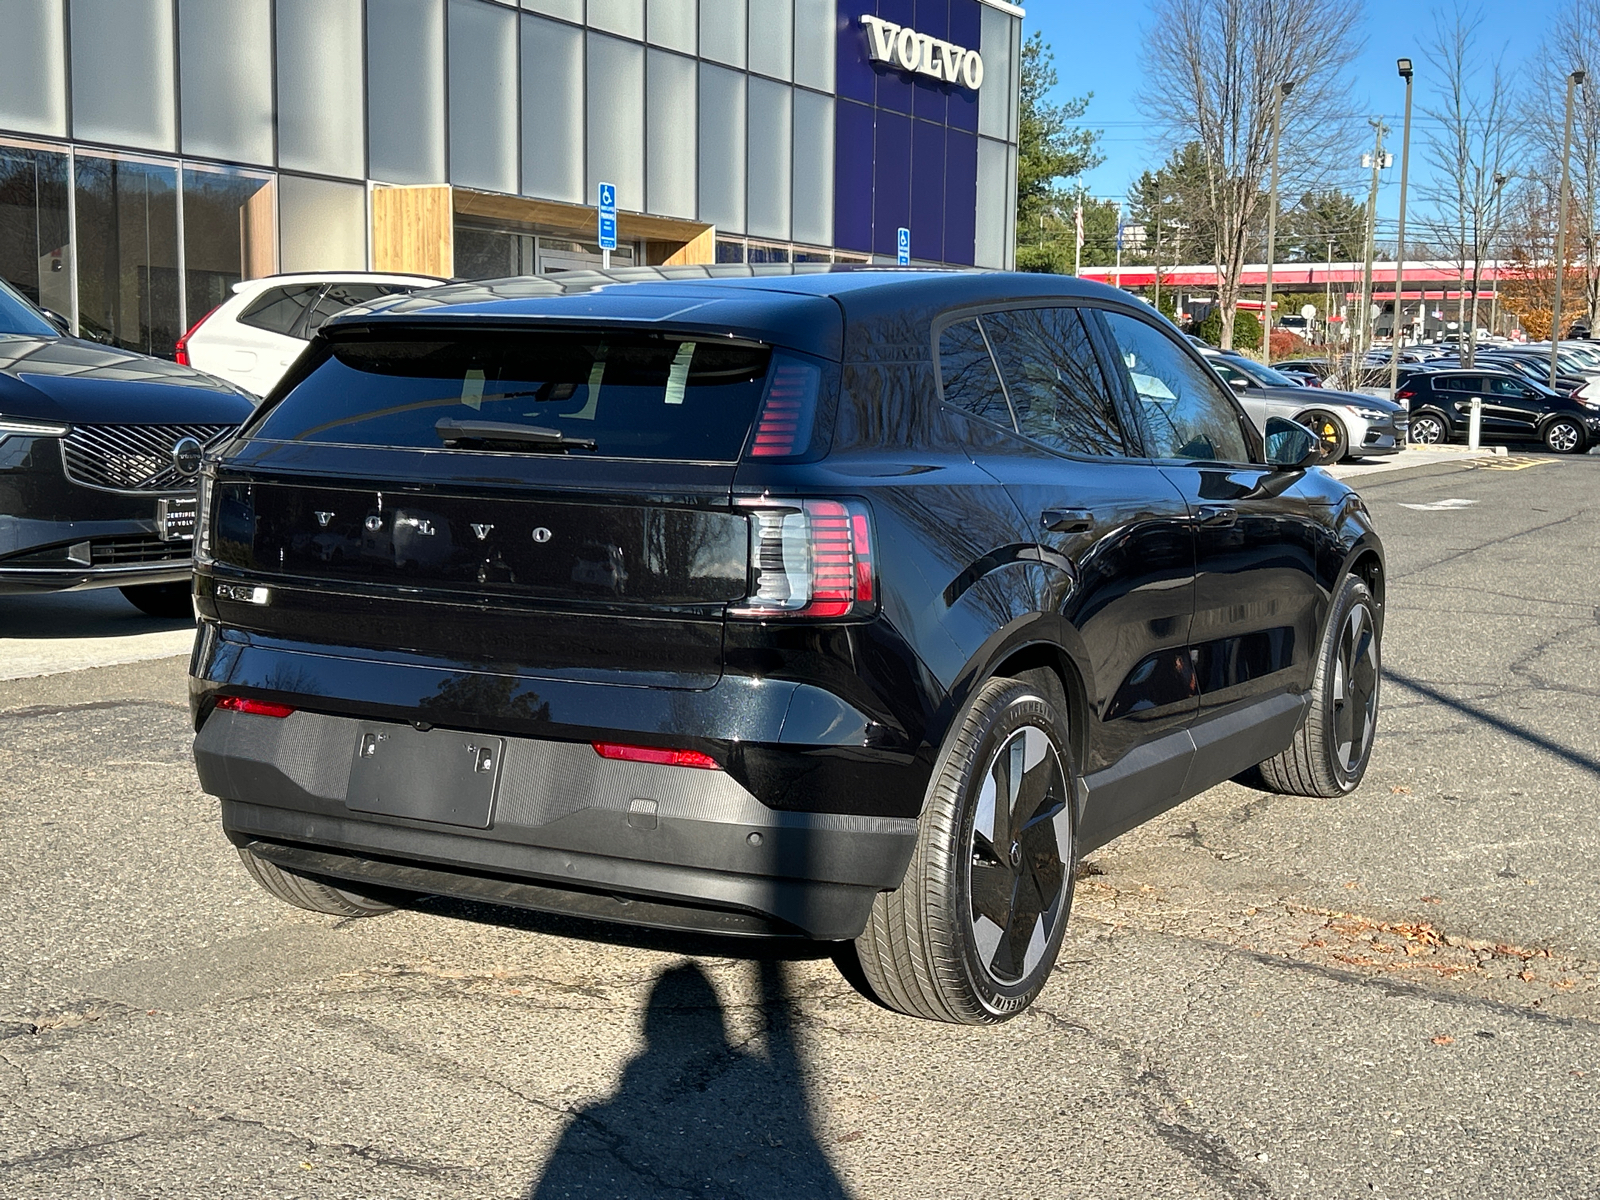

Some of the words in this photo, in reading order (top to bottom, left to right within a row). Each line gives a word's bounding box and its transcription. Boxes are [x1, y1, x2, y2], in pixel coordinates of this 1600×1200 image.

[860, 14, 984, 90] VOLVO
[166, 511, 196, 519] CERTIFIE
[314, 510, 552, 543] VOLVO
